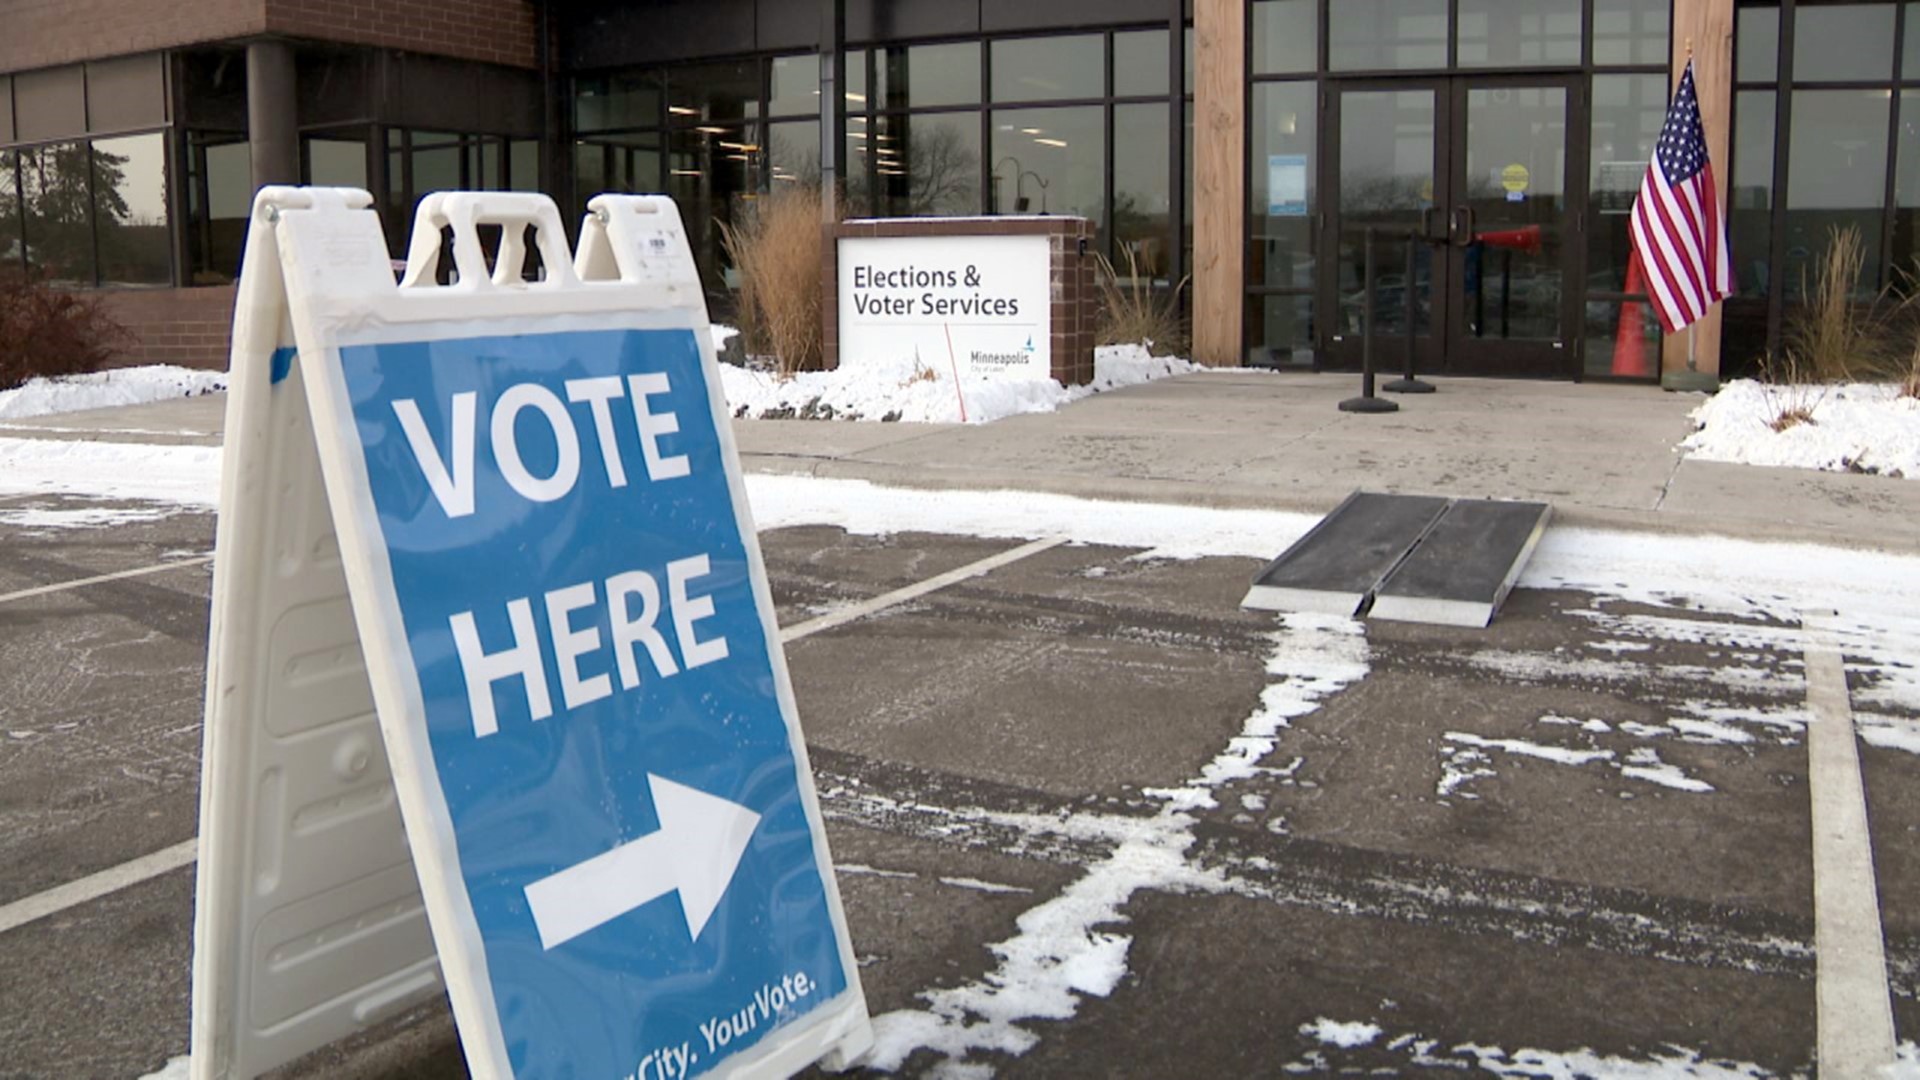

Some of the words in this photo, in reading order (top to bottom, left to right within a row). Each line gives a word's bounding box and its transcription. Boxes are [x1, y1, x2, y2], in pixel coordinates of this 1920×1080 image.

[854, 265, 957, 288] Elections
[963, 264, 981, 288] &
[854, 293, 915, 315] Voter
[921, 293, 1019, 316] Services
[970, 350, 1030, 366] Minneapolis
[391, 372, 691, 518] VOTE
[449, 553, 729, 739] HERE
[624, 1041, 698, 1080] City.
[699, 971, 816, 1054] YourVote.
